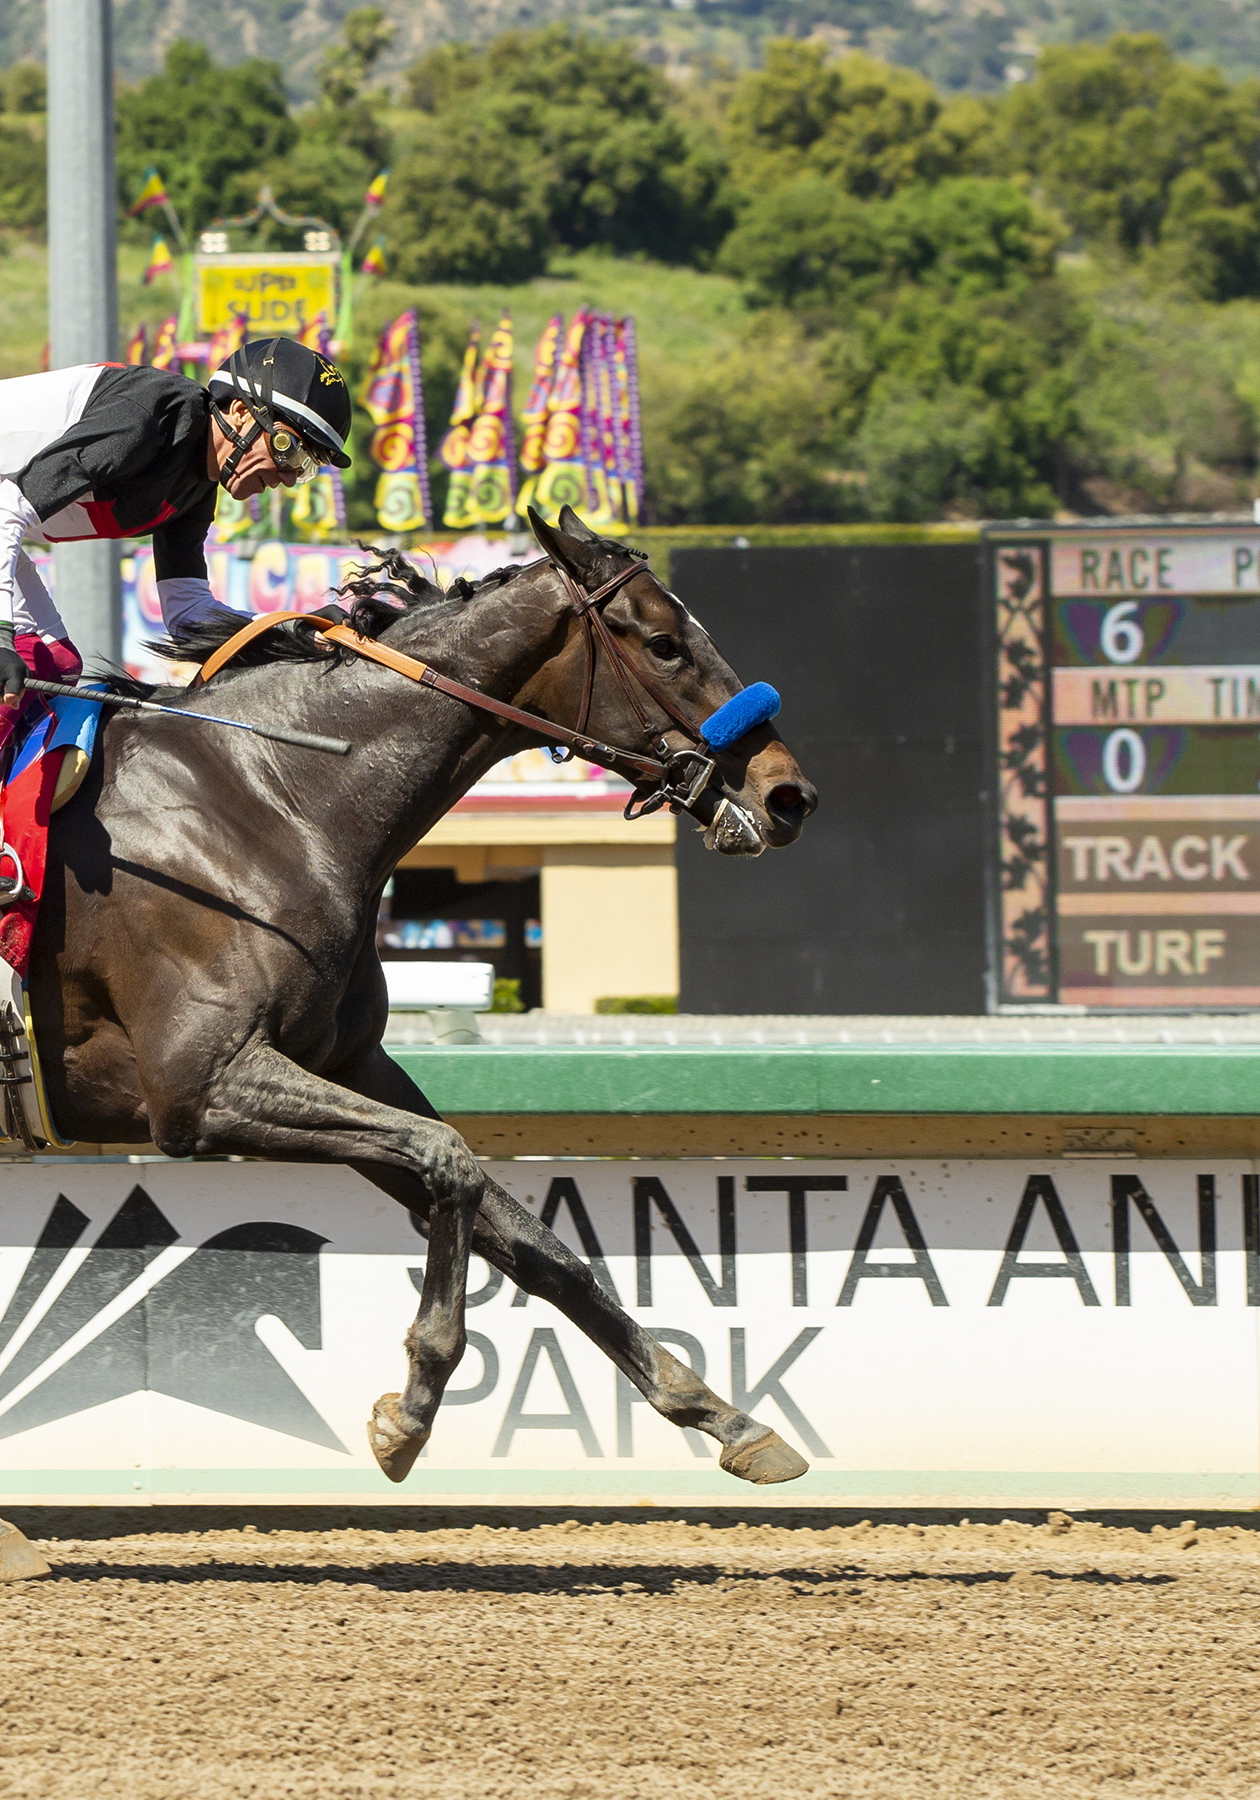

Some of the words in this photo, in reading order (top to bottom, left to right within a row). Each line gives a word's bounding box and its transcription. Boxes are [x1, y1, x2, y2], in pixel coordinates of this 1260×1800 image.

[1079, 547, 1176, 588] RACE
[1233, 546, 1260, 588] P
[1100, 600, 1144, 664] 6
[1091, 677, 1166, 718] MTP
[1101, 727, 1147, 793] 0
[1062, 836, 1249, 881] TRACK
[1083, 929, 1227, 975] TURF
